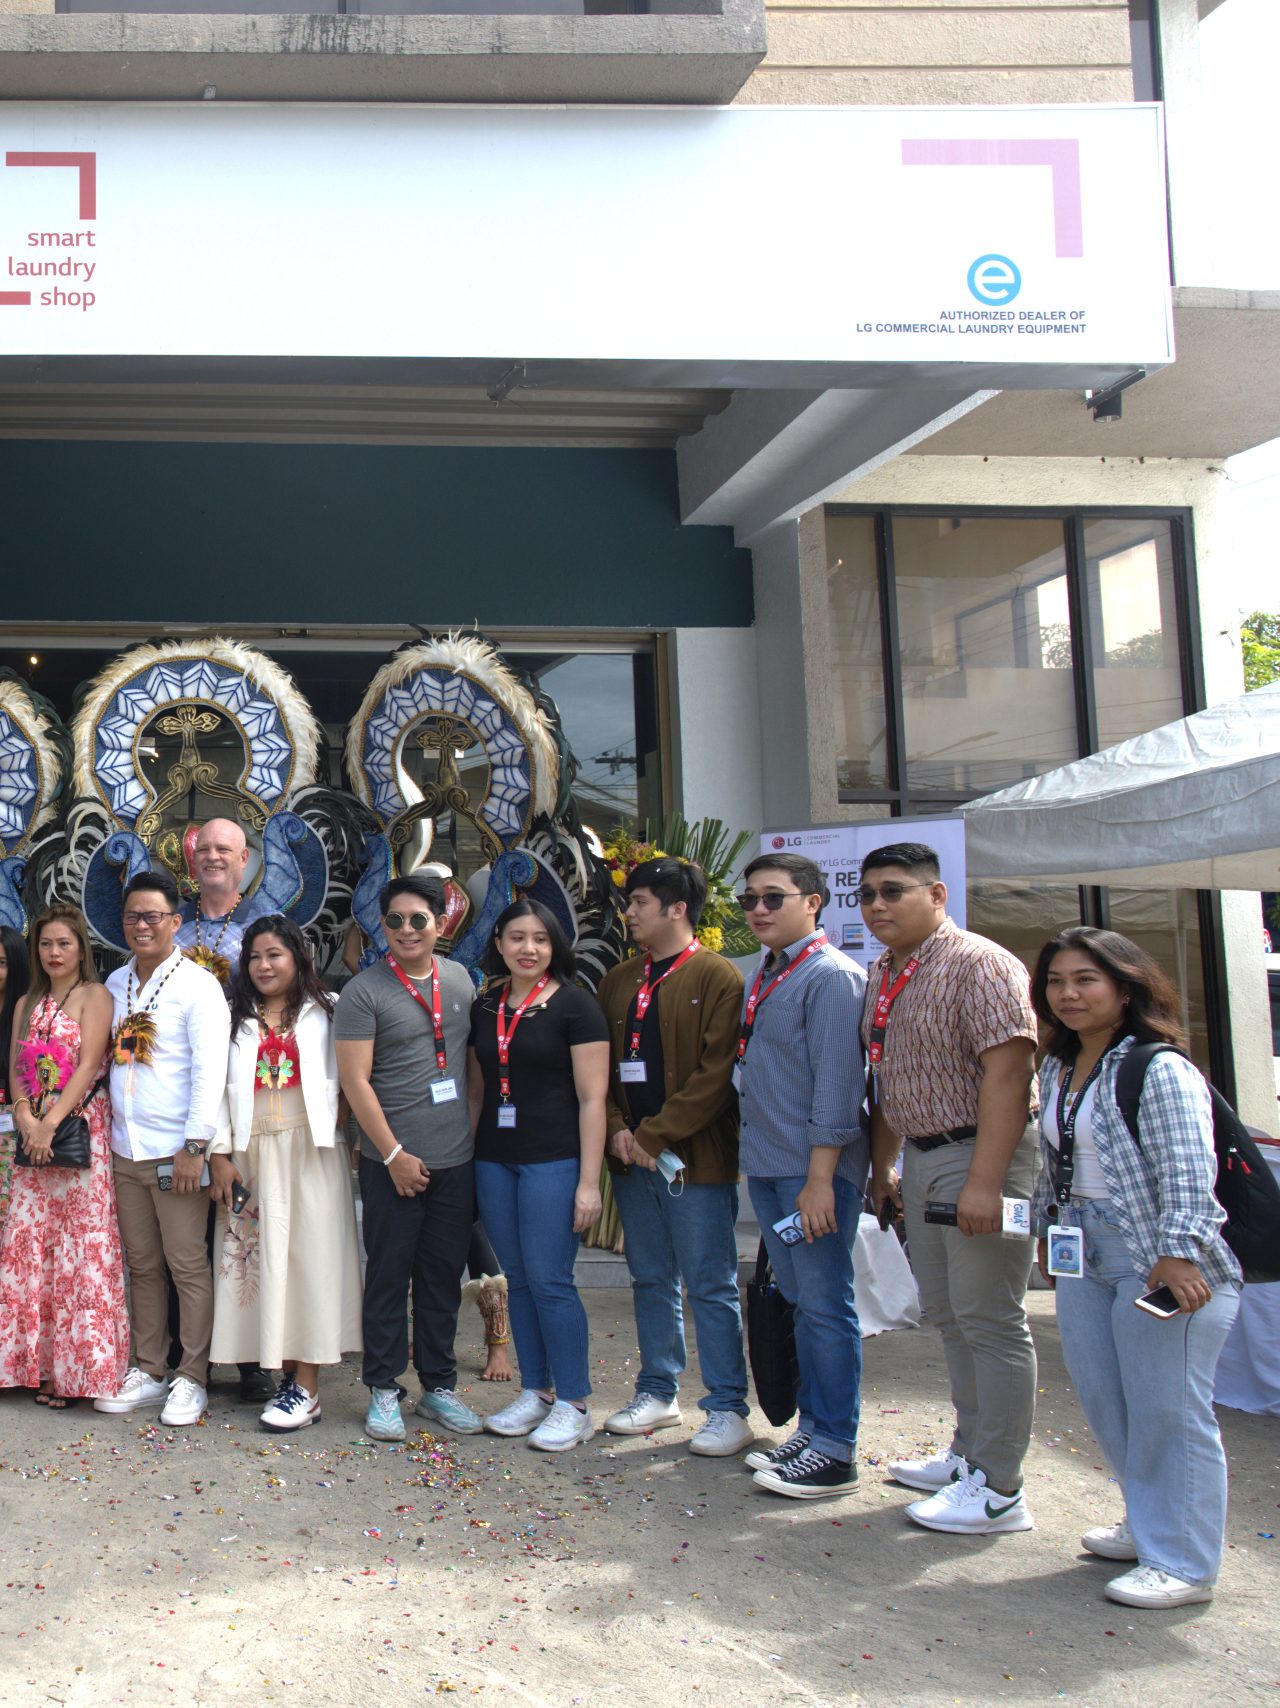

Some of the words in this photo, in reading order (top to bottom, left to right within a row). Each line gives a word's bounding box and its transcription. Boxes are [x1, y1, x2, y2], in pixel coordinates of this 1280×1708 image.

[27, 230, 96, 247] smart
[8, 255, 96, 282] laundry
[40, 286, 96, 312] shop
[939, 311, 1015, 321] AUTHORIZED
[1019, 311, 1066, 321] DEALER
[1069, 310, 1086, 320] OF
[856, 323, 872, 333] LG
[875, 323, 956, 333] COMMERCIAL
[958, 324, 1014, 334] LAUNDRY
[1018, 324, 1087, 334] EQUIPMENT
[787, 837, 802, 846] LG
